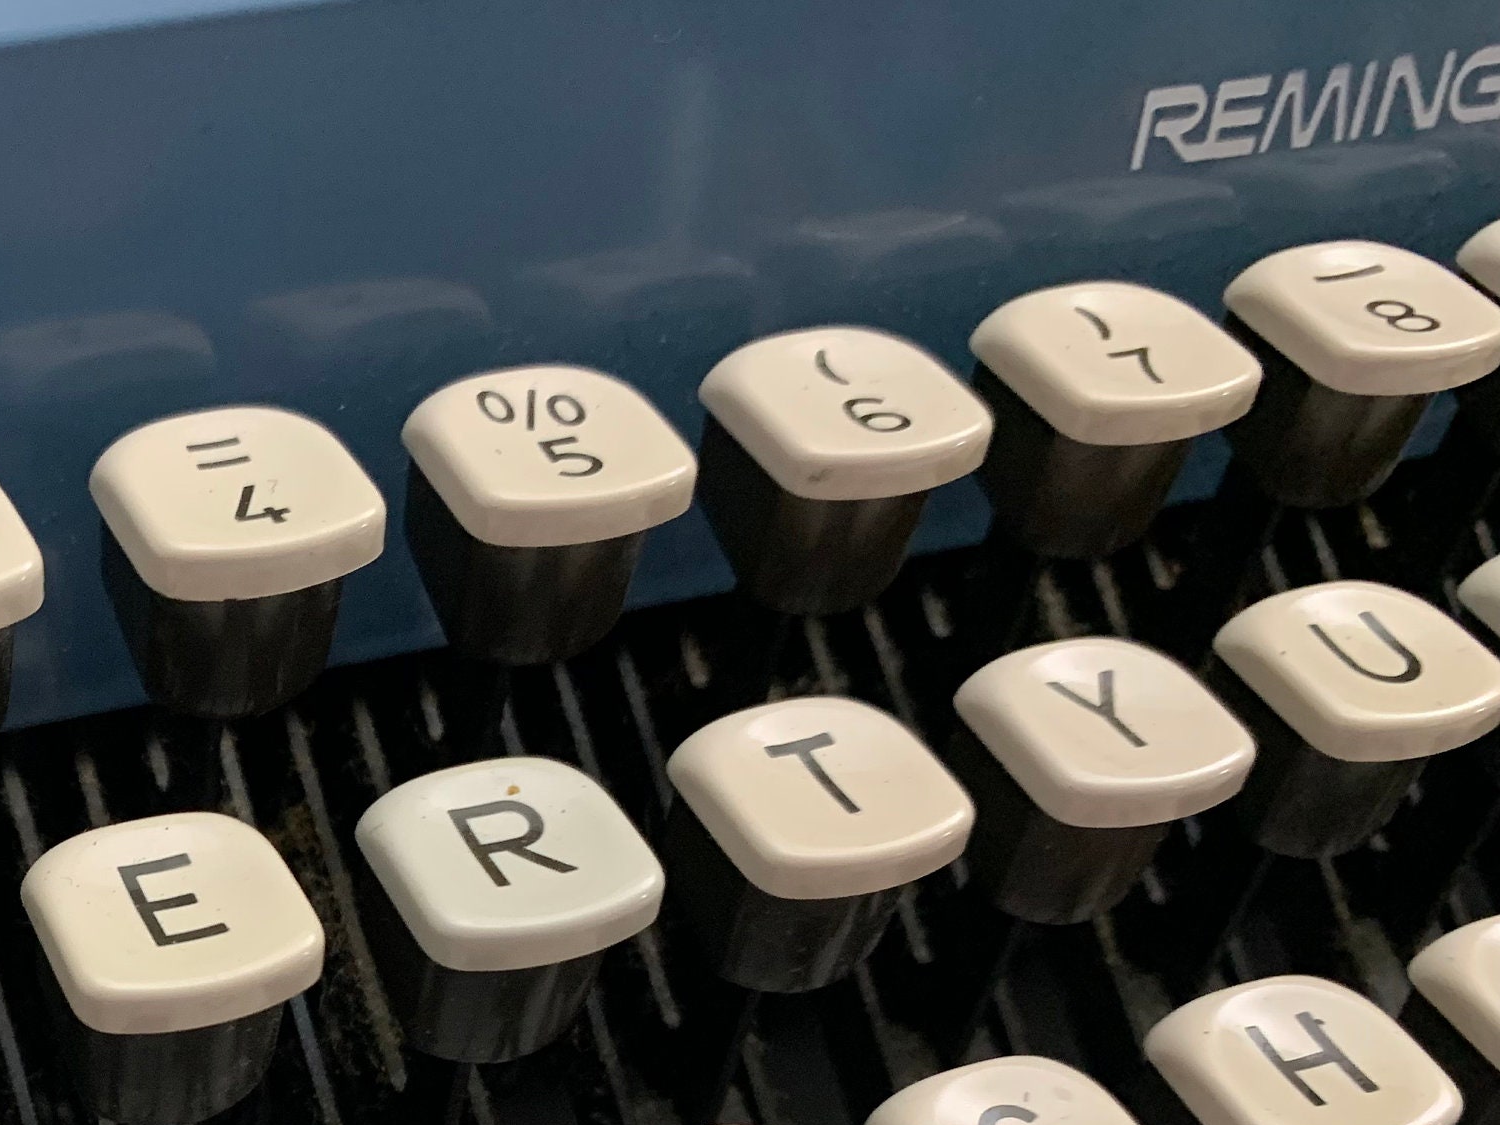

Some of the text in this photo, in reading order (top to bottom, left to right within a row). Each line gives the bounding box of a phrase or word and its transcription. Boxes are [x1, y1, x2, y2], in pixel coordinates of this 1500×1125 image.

[1366, 300, 1441, 333] 8
[1107, 345, 1164, 384] 7
[843, 398, 912, 433] 6
[186, 437, 251, 471] =
[537, 436, 604, 477] 5
[234, 484, 290, 523] 4
[1308, 611, 1422, 684] U
[1044, 670, 1148, 748] Y
[765, 732, 861, 814] T
[447, 800, 578, 888] R
[117, 853, 230, 947] E
[1244, 1011, 1381, 1106] H
